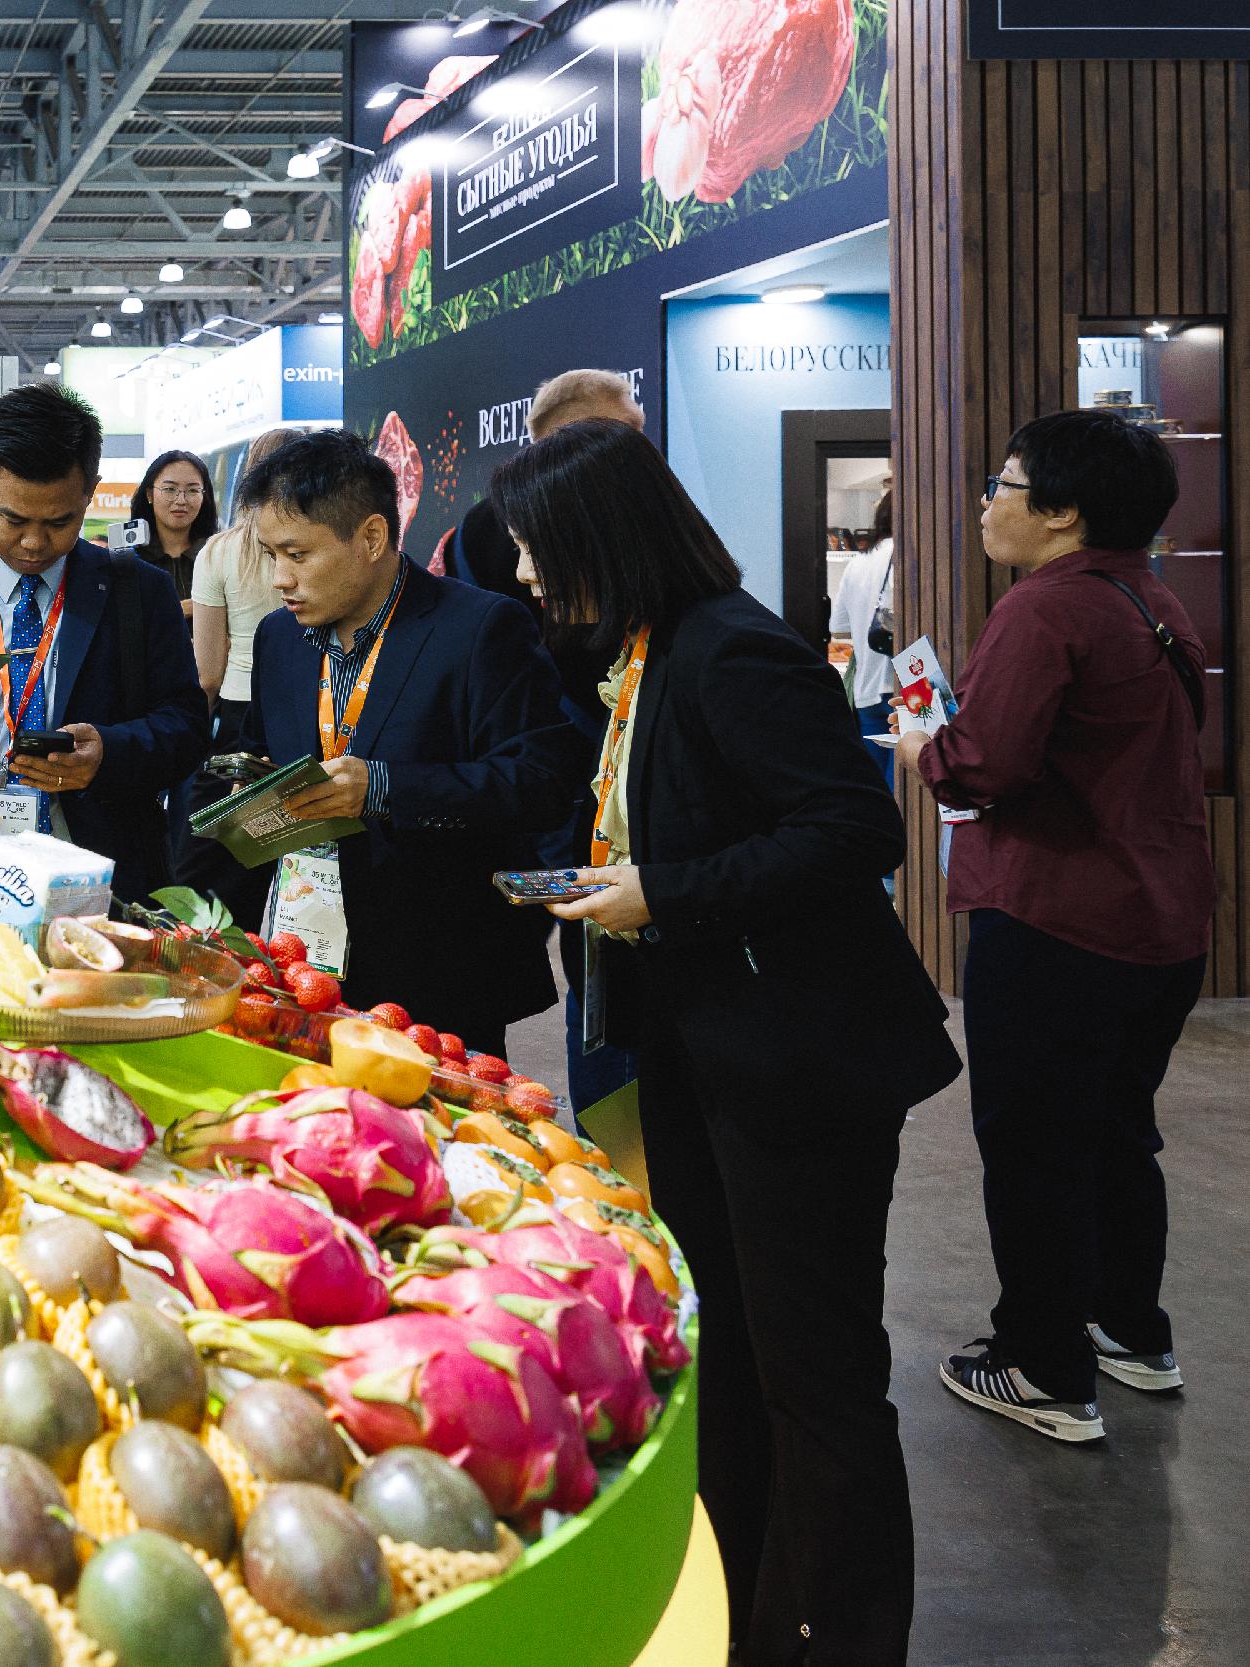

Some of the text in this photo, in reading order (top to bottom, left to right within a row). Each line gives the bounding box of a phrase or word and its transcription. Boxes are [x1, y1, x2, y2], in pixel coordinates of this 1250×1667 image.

[457, 146, 525, 217] СЫТНЫЕ
[526, 102, 599, 179] УГОДЬЯ
[479, 397, 533, 448] ВСЕГД
